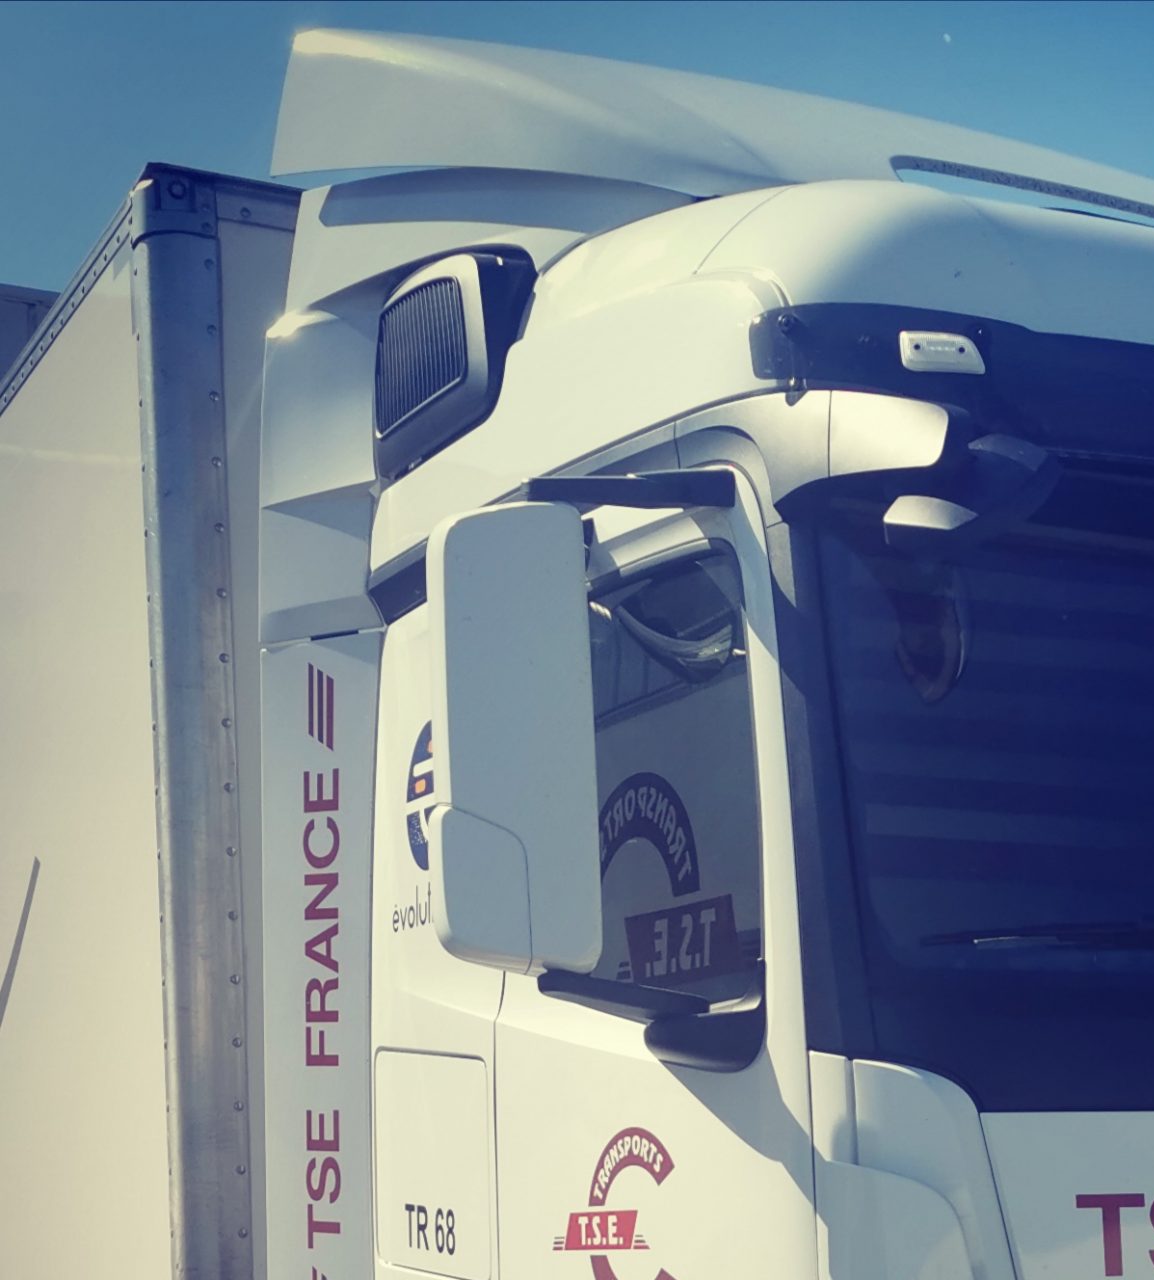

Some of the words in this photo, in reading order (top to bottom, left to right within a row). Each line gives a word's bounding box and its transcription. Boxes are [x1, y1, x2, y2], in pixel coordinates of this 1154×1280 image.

[303, 768, 340, 1067] FRANCE
[306, 1109, 341, 1249] TSE
[593, 1135, 664, 1200] TRANSPORTS
[404, 1203, 430, 1251] TR
[434, 1208, 456, 1256] 68
[578, 1214, 624, 1246] T.S.E.
